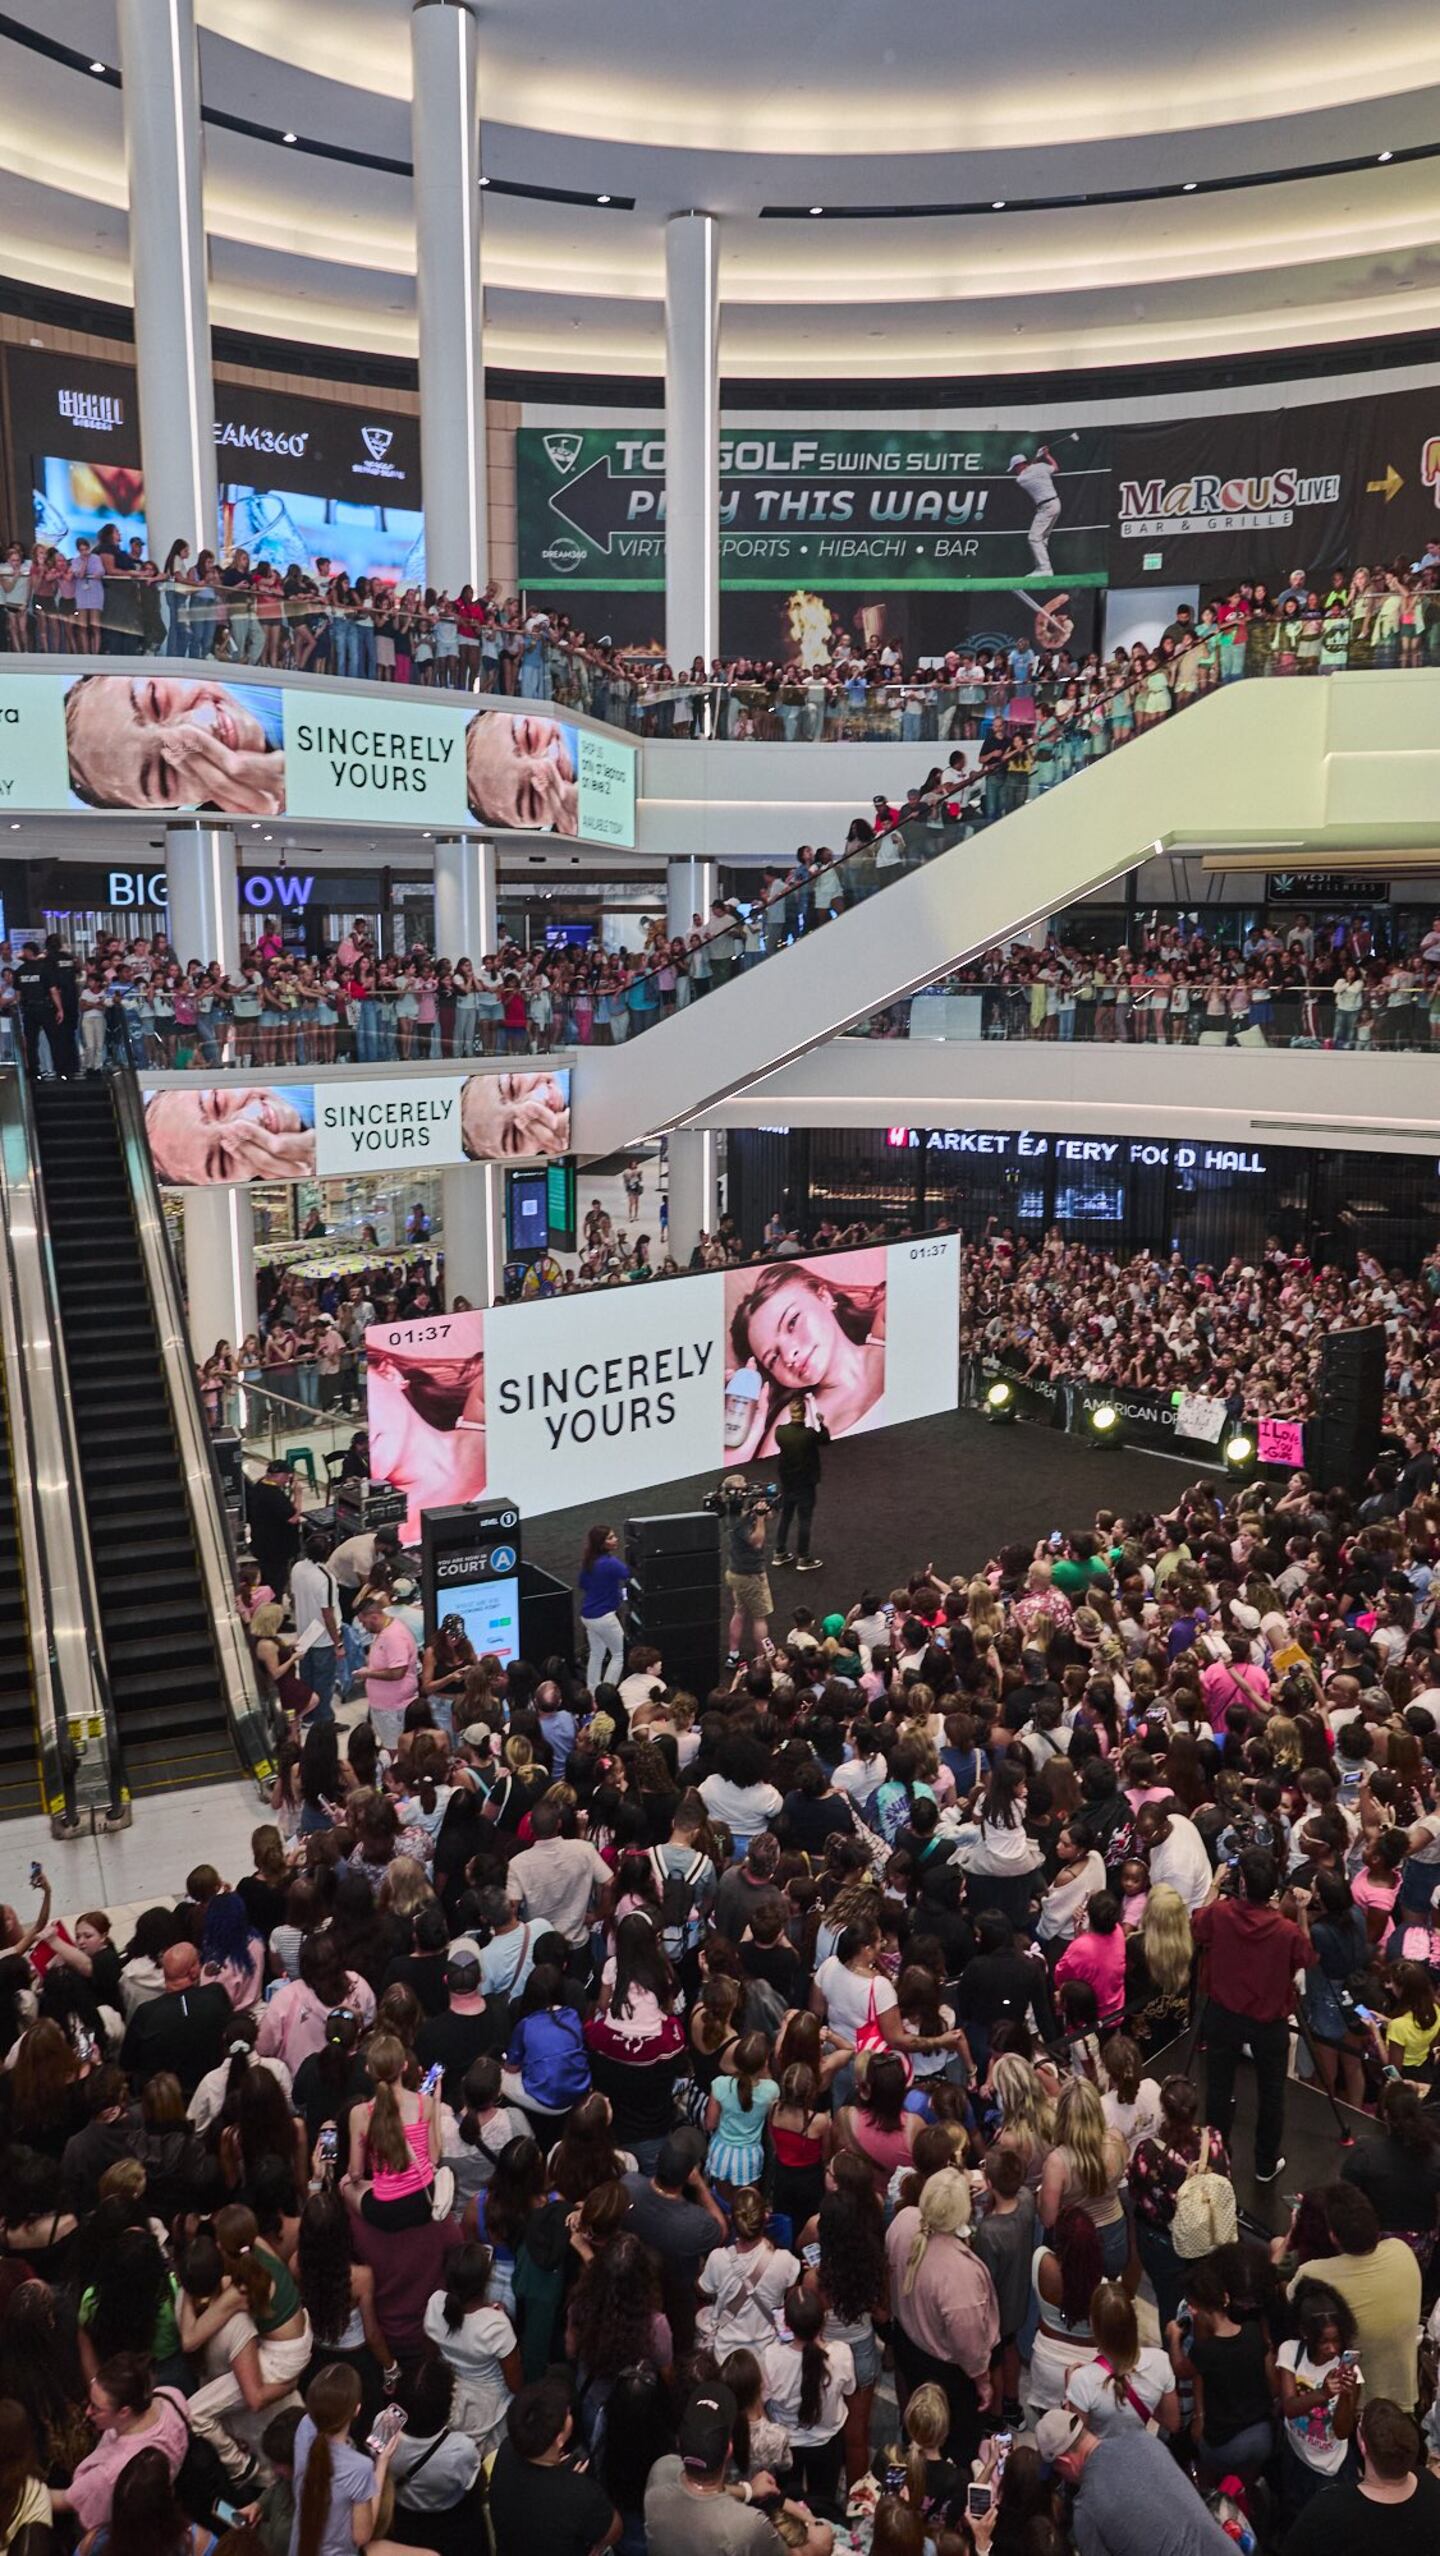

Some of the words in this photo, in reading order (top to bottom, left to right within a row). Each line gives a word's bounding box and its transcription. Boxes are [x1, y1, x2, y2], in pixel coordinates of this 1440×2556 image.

[819, 453, 901, 471] SWING
[906, 453, 983, 471] SUITE
[1298, 477, 1340, 504] LIVE!
[754, 490, 855, 521] THIS
[869, 490, 989, 525] WAY!
[1124, 520, 1165, 535] BAR
[1181, 518, 1190, 531] &
[1207, 511, 1293, 530] GRILLE
[618, 539, 667, 557] VIRT
[719, 539, 791, 557] PORTS
[818, 539, 907, 557] HIBACHI
[934, 539, 979, 557] BAR
[297, 725, 454, 763] SINCERELY
[330, 760, 427, 792] YOURS
[109, 872, 169, 906] BIG
[324, 1099, 453, 1129] SINCERELY
[351, 1126, 430, 1152] YOURS
[1205, 1149, 1267, 1173] HALL
[910, 1244, 947, 1260] 01:37
[388, 1324, 452, 1346] 01:37
[498, 1340, 714, 1414] SINCERELY
[544, 1391, 676, 1450] YOURS
[1083, 1398, 1158, 1422] AMERICAN
[437, 1560, 487, 1576] COURT
